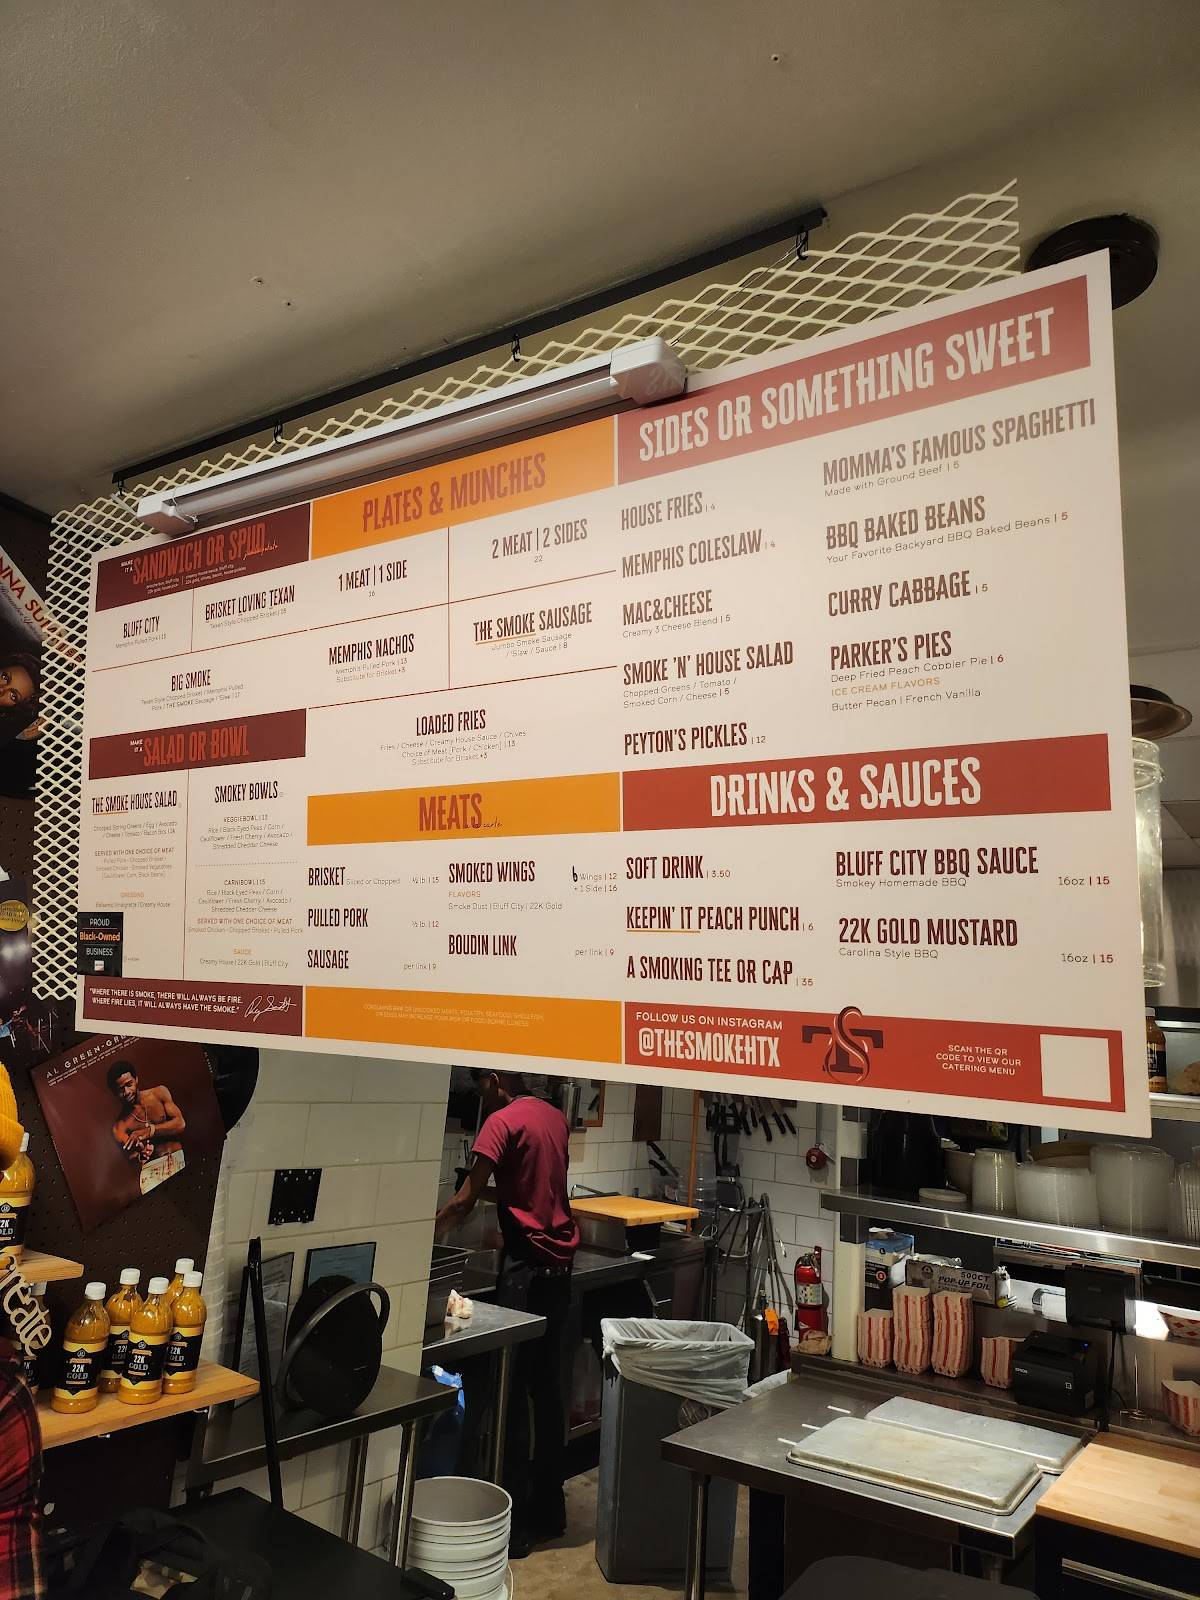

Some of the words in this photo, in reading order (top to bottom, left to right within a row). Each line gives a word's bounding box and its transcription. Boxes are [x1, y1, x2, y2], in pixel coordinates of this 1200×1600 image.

[639, 407, 709, 461] SIDES
[717, 395, 752, 441] OR
[761, 342, 934, 430] SOMETHING
[945, 307, 1054, 381] SWEET
[823, 443, 906, 486] MOMMA'S
[912, 424, 985, 466] FAMOUS
[992, 398, 1096, 447] SPAGHETTI
[363, 485, 423, 533] PLATES
[428, 480, 443, 516] &
[450, 452, 546, 512] MUNCHES
[824, 485, 851, 497] Made
[854, 479, 874, 491] with
[877, 471, 915, 486] Ground
[918, 464, 944, 477] Beef
[621, 500, 662, 530] HOUSE
[667, 491, 702, 520] FRIES
[826, 520, 858, 550] BBQ
[864, 508, 919, 543] BAKED
[924, 495, 986, 531] BEANS
[492, 538, 499, 559] 2
[503, 530, 533, 557] MEAT
[543, 527, 550, 548] 2
[554, 518, 588, 546] SIDES
[826, 552, 849, 564] Your
[851, 545, 892, 559] Favorite
[895, 535, 944, 552] Backyard
[947, 530, 972, 542] BBQ
[976, 523, 1011, 537] Baked
[1015, 517, 1050, 529] Beans
[133, 538, 202, 585] SANDWICH
[206, 534, 225, 564] OR
[229, 522, 267, 561] SPUD
[622, 545, 684, 578] MEMPHIS
[688, 528, 762, 566] COLESLAW
[346, 567, 371, 591] MEAT
[386, 559, 407, 582] SIDE
[206, 597, 237, 621] BRISKET
[238, 591, 267, 615] LOVING
[269, 584, 295, 607] TEXAN
[828, 585, 882, 617] CURRY
[888, 570, 971, 607] CABBAGE
[622, 589, 713, 626] MAC&CHEESE
[123, 618, 142, 639] BLUFF
[144, 615, 160, 635] CITY
[473, 619, 493, 642] THE
[496, 611, 535, 638] SMOKE
[539, 602, 593, 631] SAUSAGE
[328, 640, 373, 666] MEMPHIS
[375, 633, 415, 658] NACHOS
[830, 637, 908, 670] PARKER'S
[914, 631, 952, 660] PIES
[623, 658, 669, 685] SMOKE
[696, 648, 741, 676] HOUSE
[746, 641, 793, 670] SALAD
[831, 671, 857, 683] Deep
[859, 669, 885, 679] Fried
[888, 665, 920, 675] Peach
[970, 657, 987, 666] Pie
[171, 674, 184, 691] BIG
[185, 669, 212, 689] SMOKE
[850, 683, 887, 695] CREAM
[890, 677, 940, 690] FLAVORS
[905, 693, 942, 704] French
[945, 688, 982, 700] Vanilla
[416, 713, 454, 736] LOADED
[458, 709, 486, 732] FRIES
[143, 733, 185, 767] SALAD
[189, 730, 207, 762] OR
[210, 725, 249, 759] BOWL
[624, 728, 686, 755] PEYTON'S
[691, 722, 747, 750] PICKLES
[215, 784, 247, 803] SMOKEY
[249, 780, 278, 801] BOWLS
[710, 768, 816, 817] DRINKS
[826, 766, 849, 811] &
[860, 757, 981, 810] SAUCES
[92, 797, 104, 813] THE
[105, 795, 129, 812] SMOKE
[130, 792, 153, 810] HOUSE
[154, 790, 177, 808] SALAD
[419, 792, 482, 832] MEATS
[448, 862, 493, 883] SMOKED
[496, 861, 536, 883] WINGS
[626, 856, 657, 880] SOFT
[662, 855, 704, 879] DRINK
[835, 850, 884, 877] BLUFF
[889, 849, 928, 876] CITY
[934, 848, 970, 877] BBQ
[976, 846, 1039, 875] SAUCE
[308, 866, 346, 886] BRISKET
[835, 878, 877, 889] Smokey
[879, 877, 939, 888] Homemade
[941, 877, 967, 888] BBQ
[89, 918, 110, 926] PROUD
[308, 908, 340, 927] PULLED
[343, 908, 369, 927] PORK
[626, 906, 675, 930] KEEPIN'
[680, 906, 693, 930] IT
[699, 906, 743, 931] PEACH
[749, 906, 799, 931] PUNCH
[79, 931, 121, 941] Black-Owned
[838, 917, 871, 944] 22K
[877, 918, 920, 945] GOLD
[927, 918, 1018, 947] MUSTARD
[86, 947, 114, 956] BUSINESS
[448, 934, 489, 955] BOUDIN
[493, 934, 517, 956] LINK
[838, 948, 881, 957] Carolina
[913, 949, 939, 960] BBQ
[307, 949, 349, 969] SAUSAGE
[627, 955, 635, 978] A
[640, 955, 703, 982] SMOKING
[708, 958, 732, 983] TEE
[736, 958, 757, 984] OR
[762, 959, 793, 985] CAP
[92, 997, 110, 1005] WHERE
[111, 998, 123, 1006] FIRE
[144, 1000, 157, 1008] WILL
[158, 1001, 182, 1010] ALWAYS
[183, 1002, 199, 1011] HAVE
[200, 1003, 212, 1012] THE
[110, 989, 128, 997] THERE
[157, 991, 176, 1000] THERE
[176, 992, 191, 1000] WILL
[191, 993, 216, 1002] ALWAYS
[636, 1011, 678, 1023] FOLLOW
[681, 1014, 696, 1025] US
[698, 1015, 715, 1026] ON
[717, 1016, 783, 1030] INSTAGRAM
[638, 1027, 781, 1068] @THESMOKEHTX
[948, 1044, 972, 1053] SCAN
[974, 1046, 992, 1055] THE
[994, 1047, 1008, 1056] QR
[935, 1053, 961, 1062] CODE
[963, 1054, 975, 1063] TO
[976, 1056, 999, 1065] VIEW
[1001, 1057, 1022, 1067] OUR
[942, 1062, 987, 1073] CATERING
[988, 1066, 1015, 1076] MENU
[46, 1067, 60, 1079] AL
[960, 1271, 990, 1282] 500CT
[971, 1281, 991, 1291] FOIL
[133, 1355, 145, 1363] 22K
[170, 1346, 181, 1354] 22K
[66, 1372, 89, 1380] GOLD
[71, 1364, 84, 1373] 22K
[128, 1362, 149, 1371] GOLD
